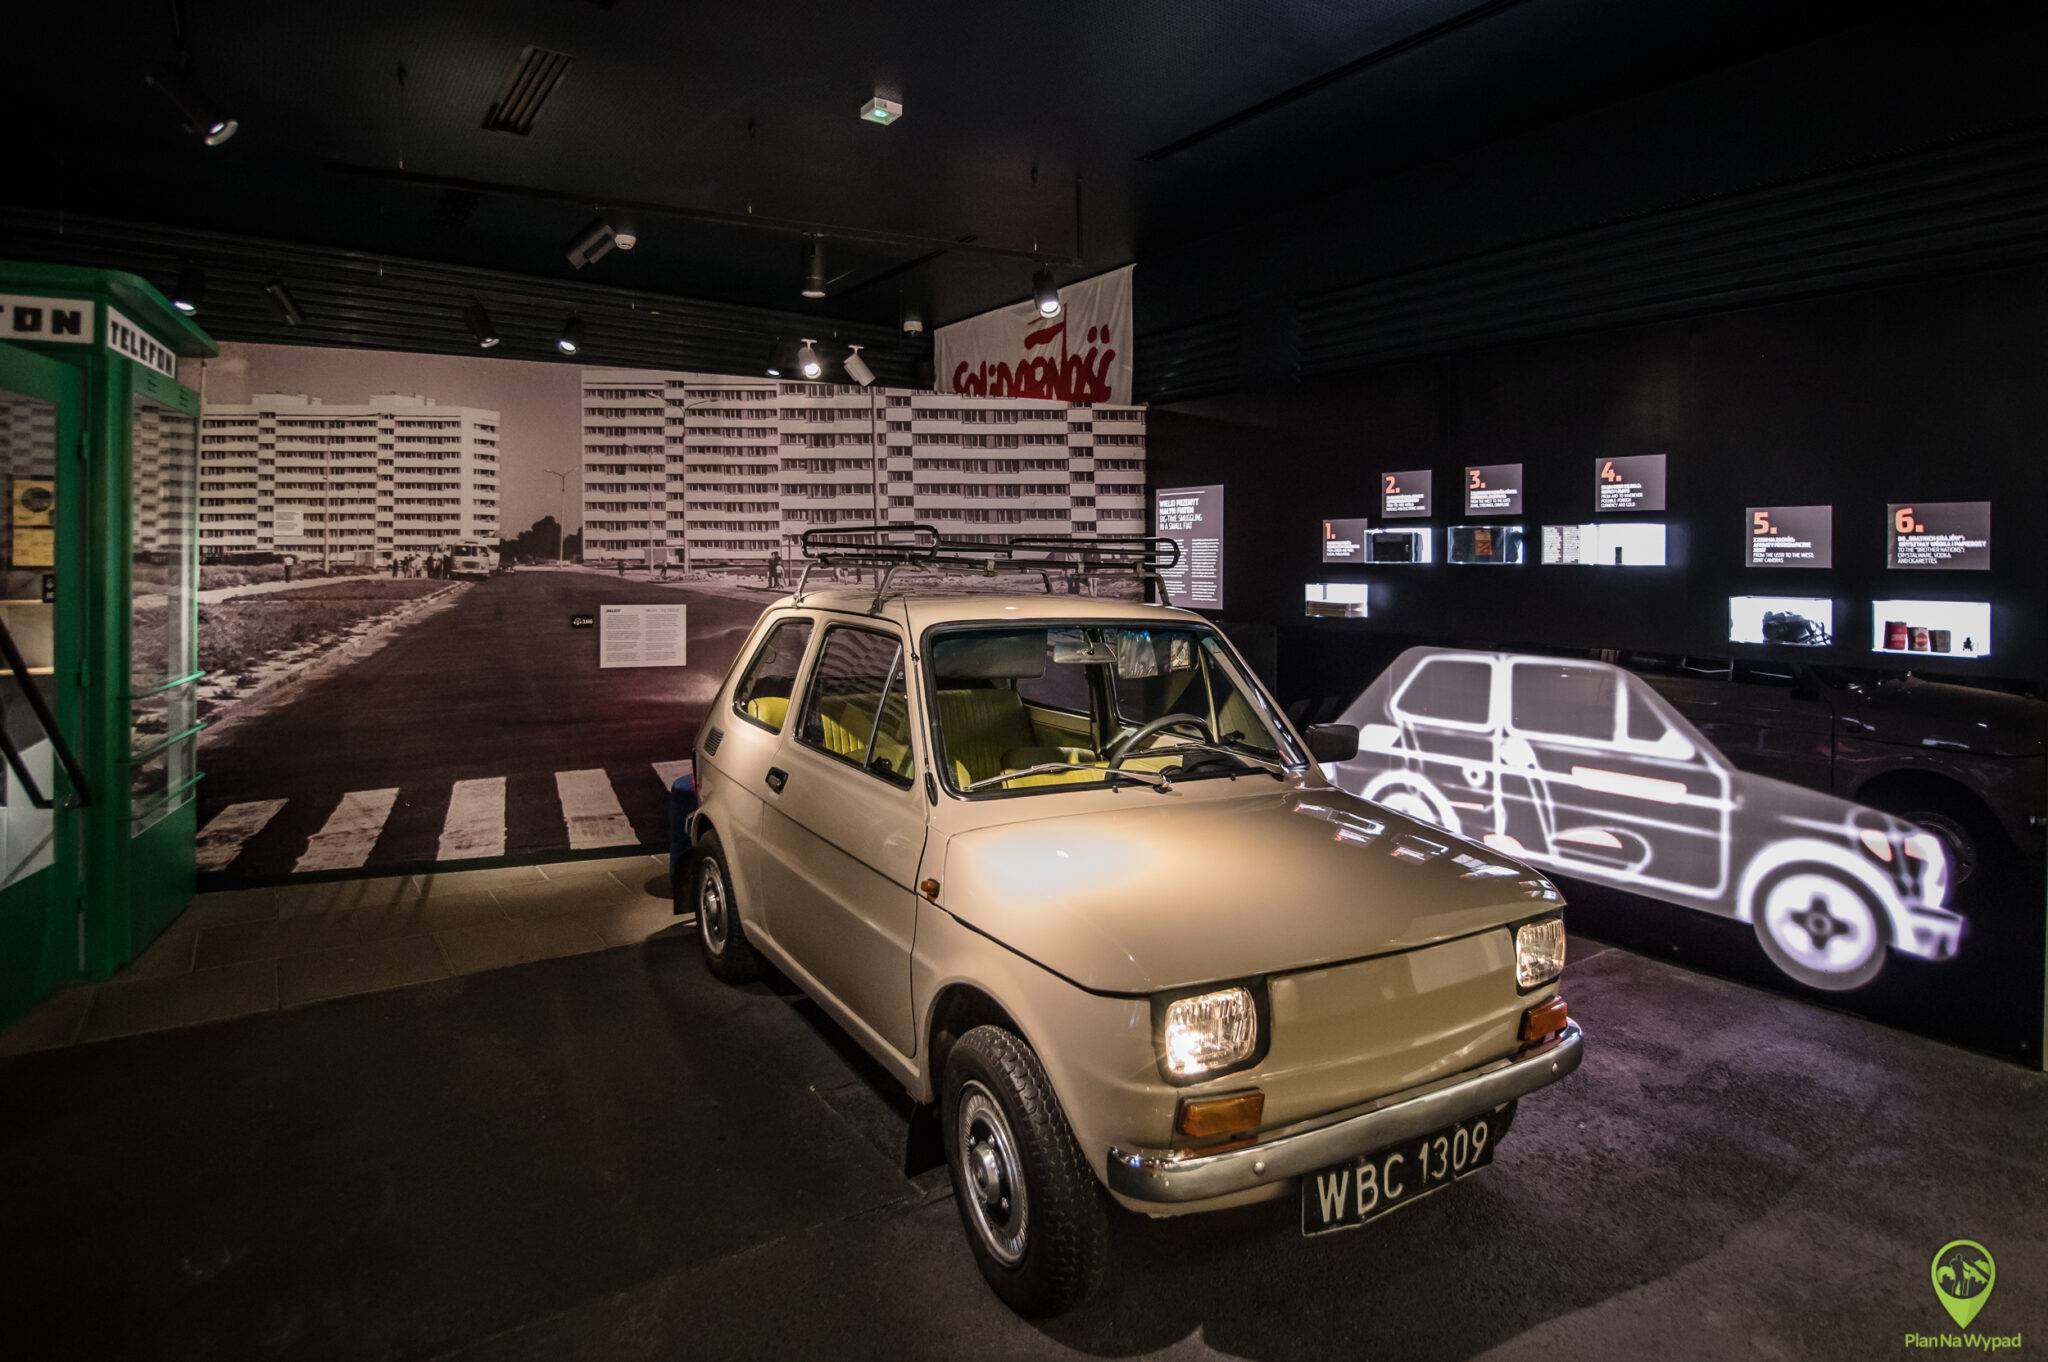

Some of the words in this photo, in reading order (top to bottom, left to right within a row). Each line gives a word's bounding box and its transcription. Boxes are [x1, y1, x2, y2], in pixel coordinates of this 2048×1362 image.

[0, 305, 81, 335] ON
[111, 320, 173, 376] TELEFON
[1470, 470, 1486, 489] 3.
[1601, 461, 1622, 482] 4.
[1385, 475, 1400, 494] 2.
[1325, 522, 1336, 540] 1.
[1753, 511, 1778, 535] 5.
[1895, 507, 1924, 534] 6.
[1316, 1153, 1404, 1223] WBC
[1418, 1120, 1488, 1184] 1309
